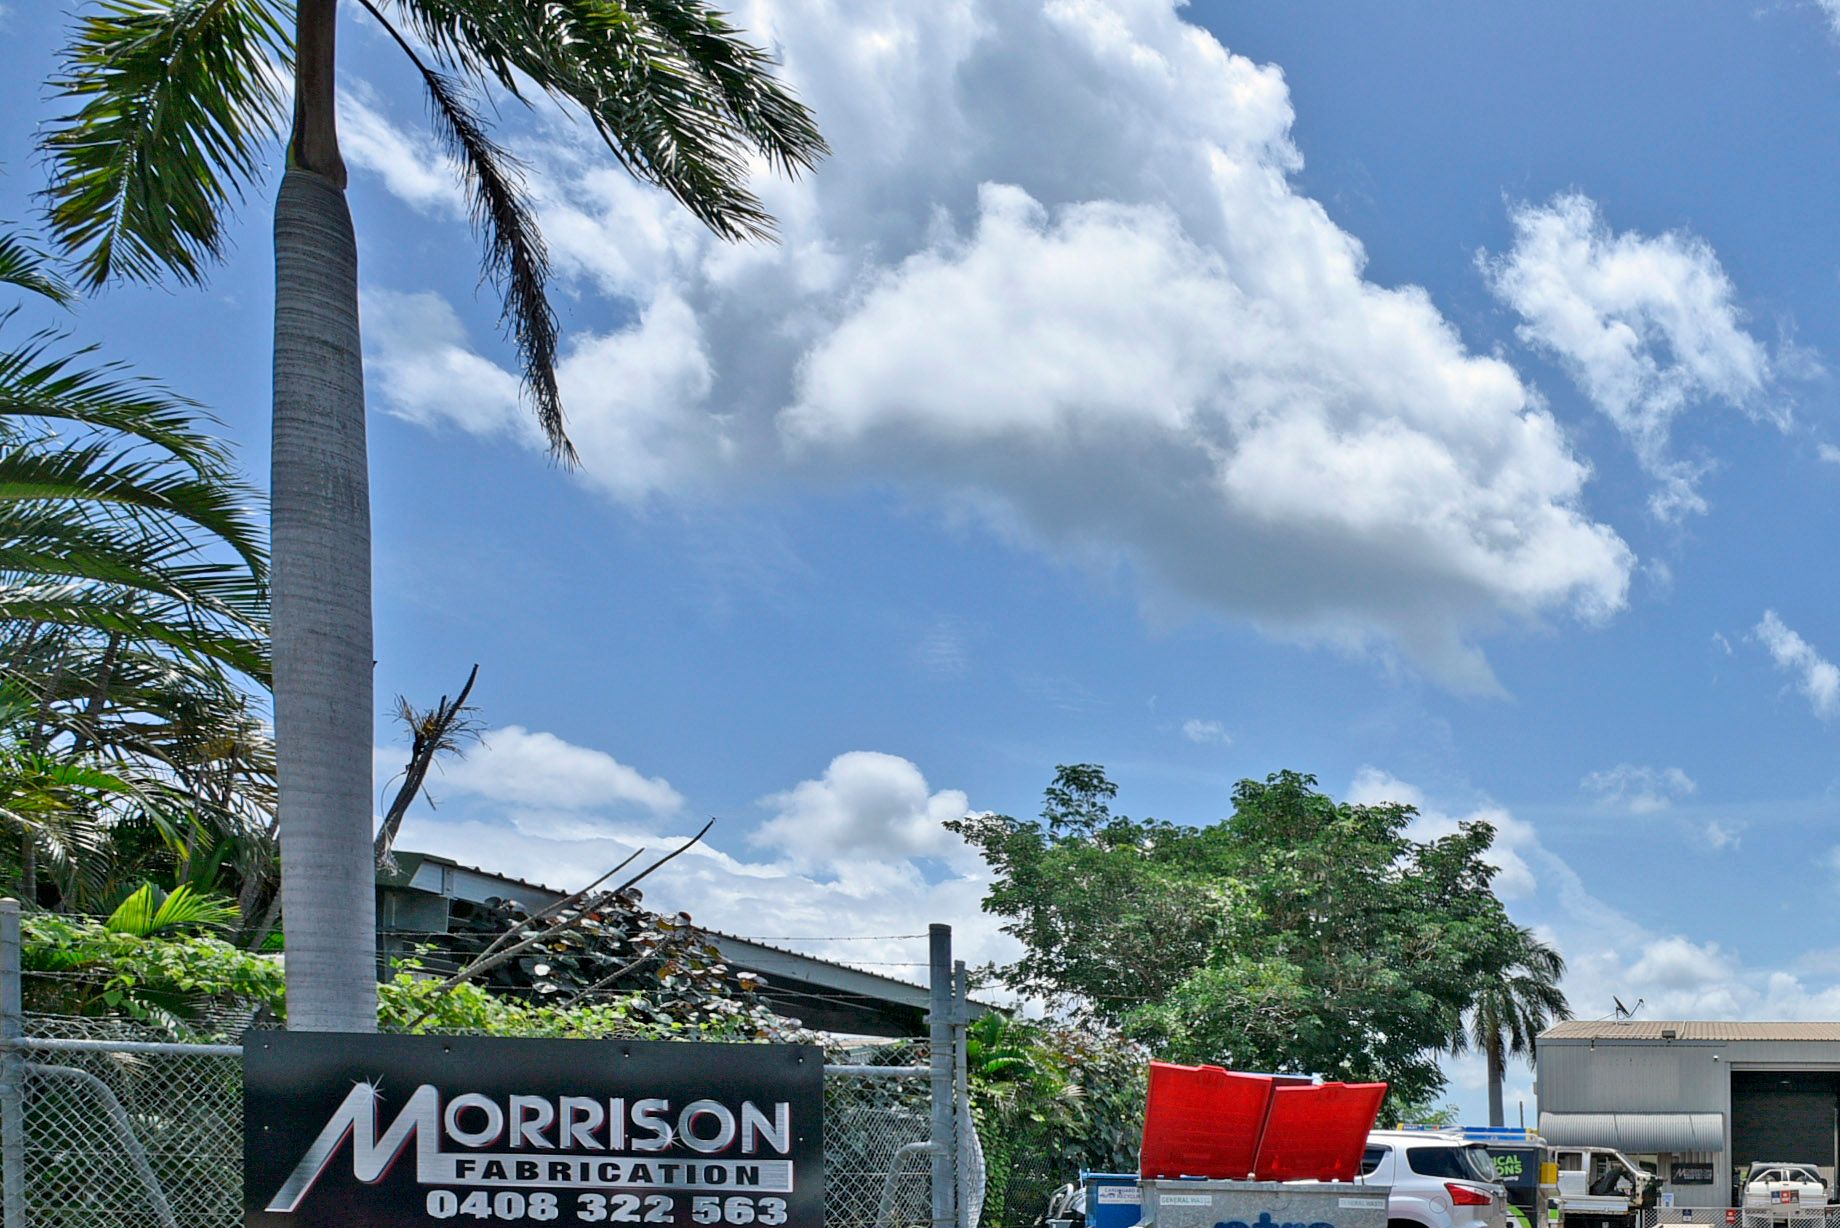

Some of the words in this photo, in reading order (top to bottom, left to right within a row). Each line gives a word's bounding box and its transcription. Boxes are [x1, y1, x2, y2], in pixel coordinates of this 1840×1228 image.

[264, 1082, 790, 1213] MORRISON
[455, 1159, 760, 1186] FABRICATION
[426, 1190, 559, 1221] 0408
[576, 1193, 675, 1224] 322
[691, 1196, 788, 1226] 563
